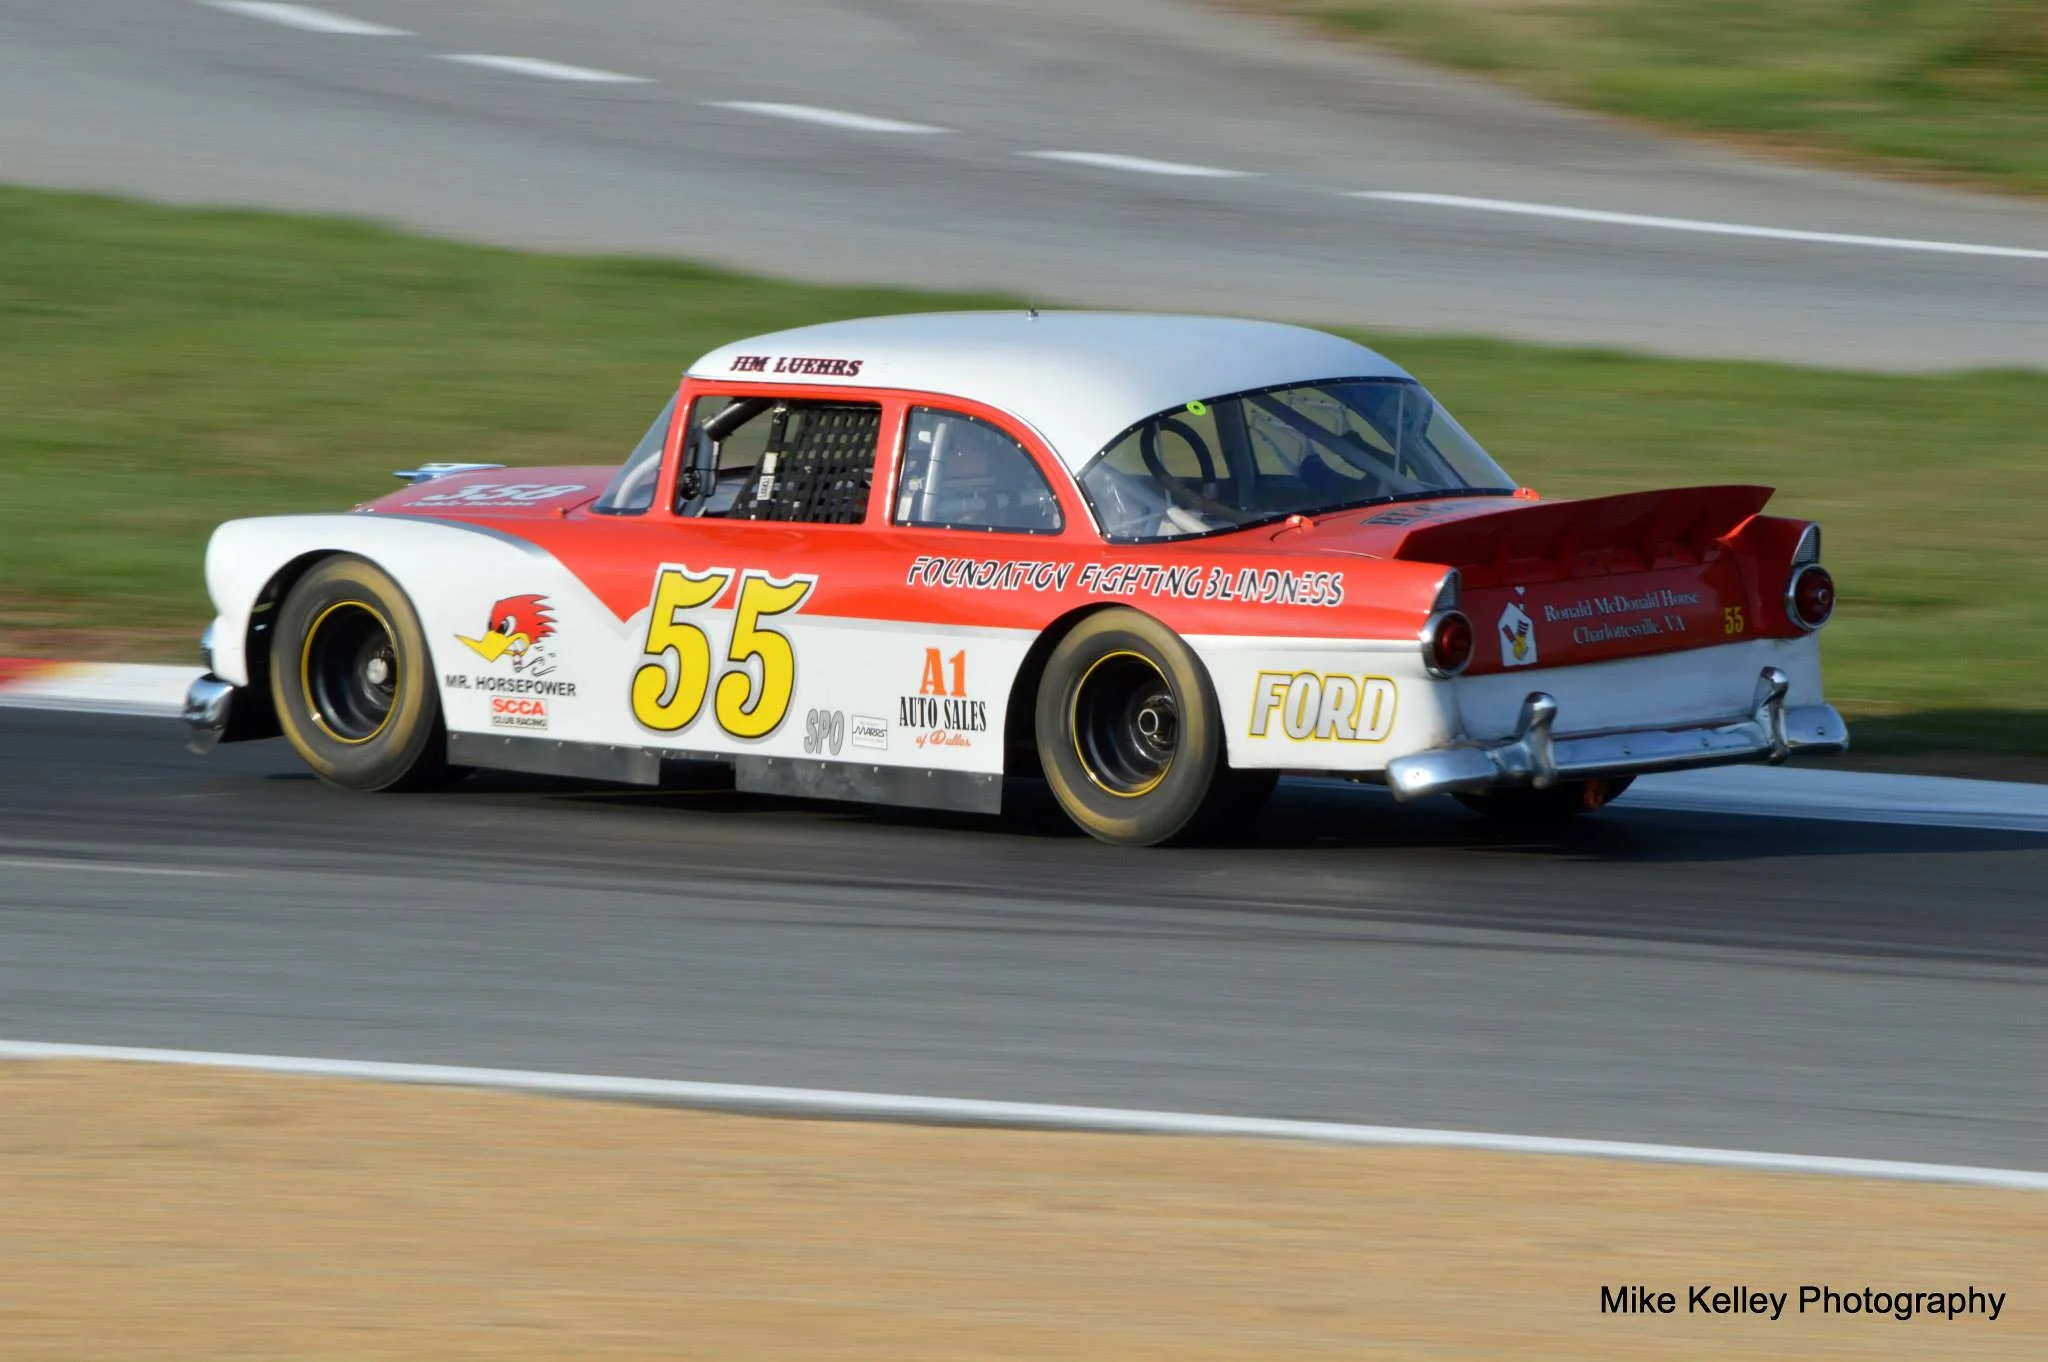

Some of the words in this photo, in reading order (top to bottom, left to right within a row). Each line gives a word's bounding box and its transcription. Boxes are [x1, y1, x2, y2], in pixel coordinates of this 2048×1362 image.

[729, 356, 771, 373] JIM
[773, 357, 864, 377] LUEHRS
[906, 555, 1074, 592] FOUNDATION
[1077, 562, 1203, 598] FIGHTING
[1204, 565, 1344, 608] BLINDNESS
[1544, 600, 1593, 622] Ronald
[1595, 590, 1660, 615] McDonald
[1661, 588, 1699, 606] House
[1723, 606, 1745, 635] 55
[629, 565, 816, 741] 55
[445, 674, 472, 690] MR.
[475, 676, 577, 697] HORSEPOWER
[919, 646, 967, 697] A1
[492, 698, 545, 716] SCCA
[515, 717, 547, 728] RACING
[900, 696, 938, 729] AUTO
[944, 698, 987, 732] SALES
[1248, 669, 1399, 745] FORD
[804, 708, 845, 756] SPO
[916, 733, 928, 749] of
